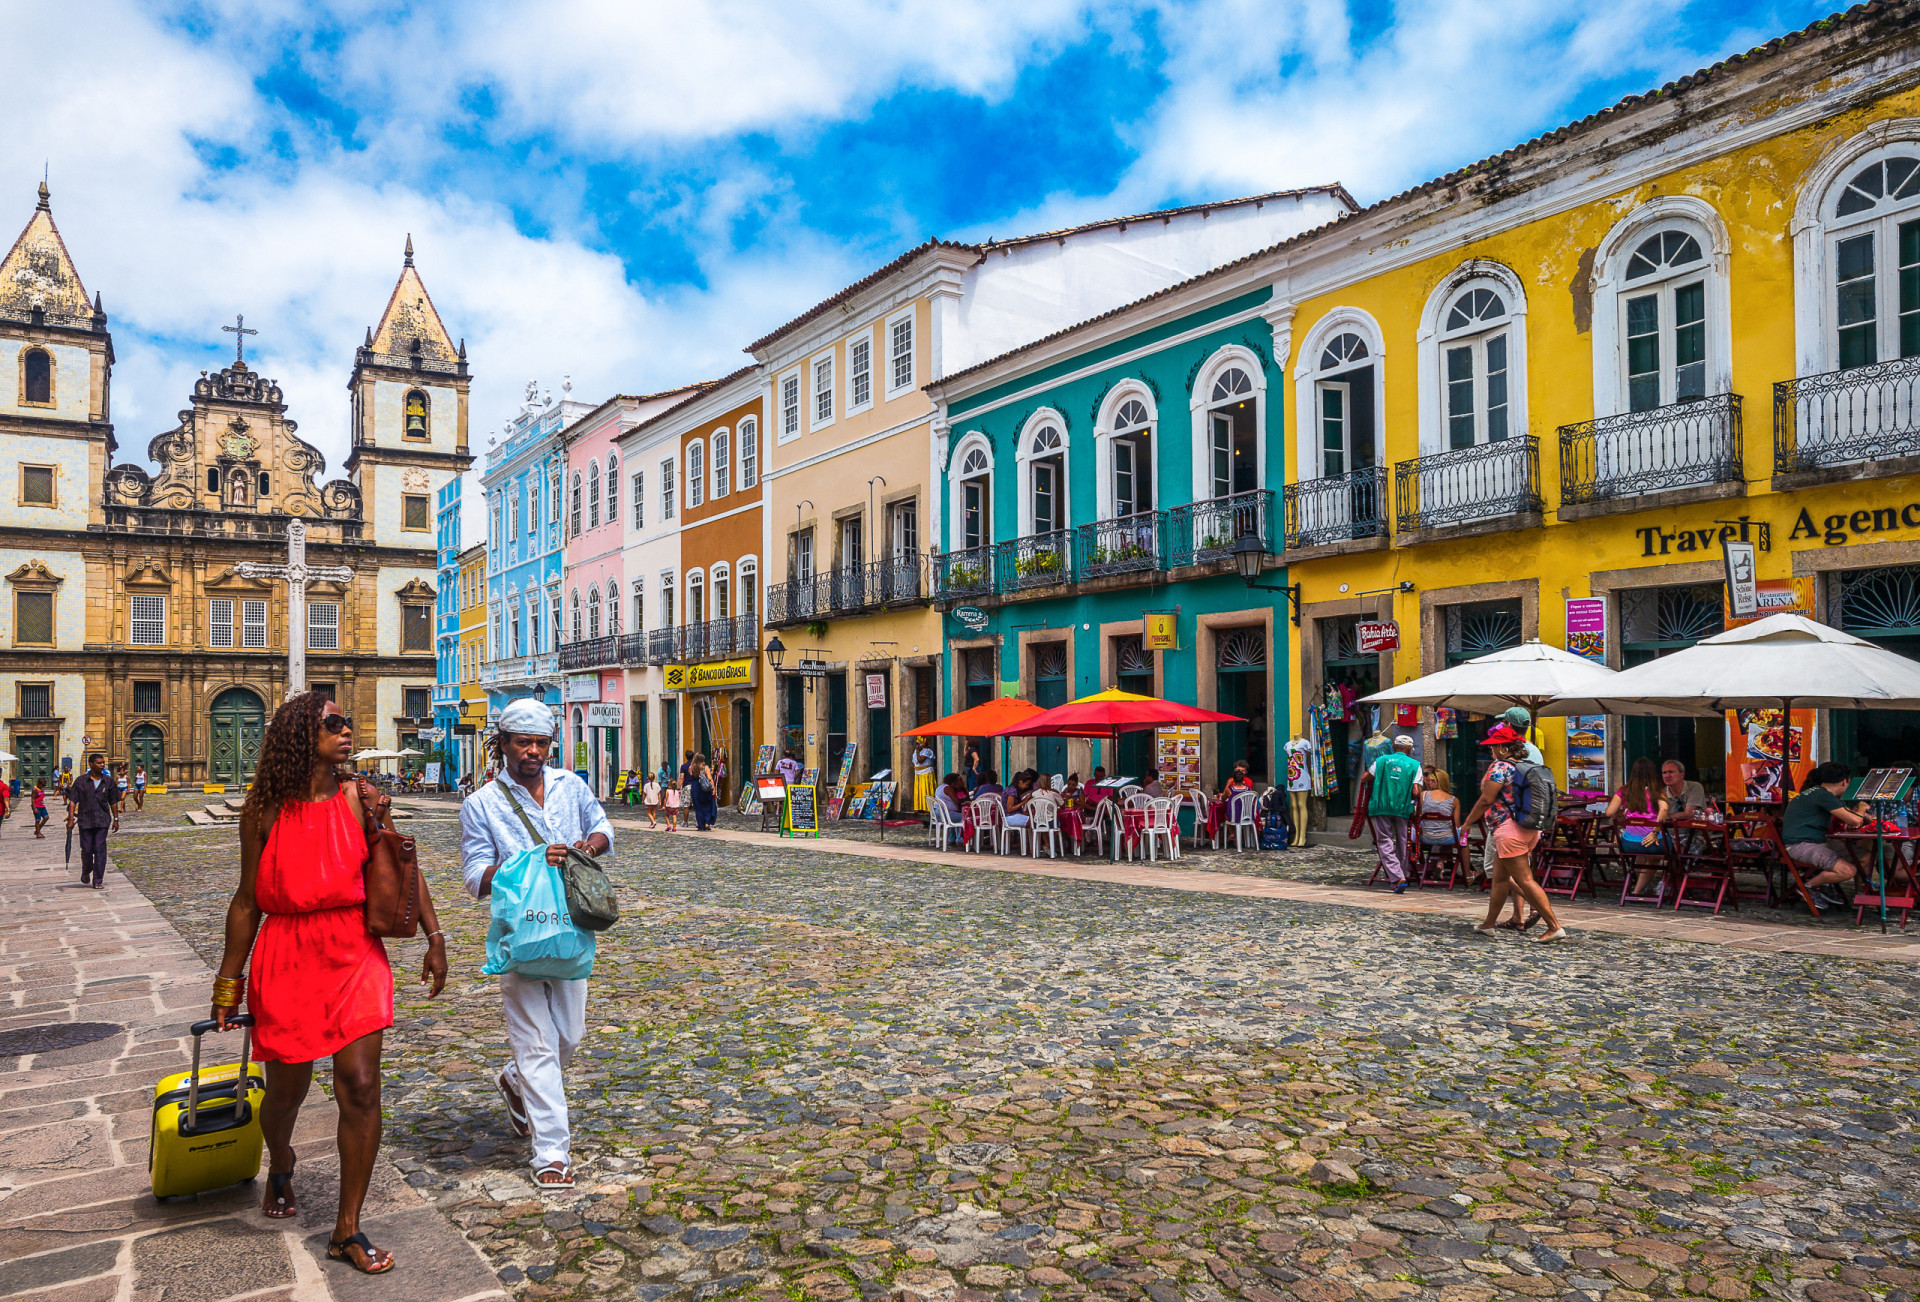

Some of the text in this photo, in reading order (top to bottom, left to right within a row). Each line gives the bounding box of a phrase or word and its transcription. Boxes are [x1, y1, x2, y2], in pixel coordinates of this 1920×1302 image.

[1636, 515, 1750, 556] Travel
[1738, 593, 1752, 604] Reise
[956, 609, 978, 617] Ramma
[1361, 626, 1380, 640] Bahia
[698, 665, 747, 681] BANCO DO BRASIL
[591, 706, 620, 717] ADVOCATUS
